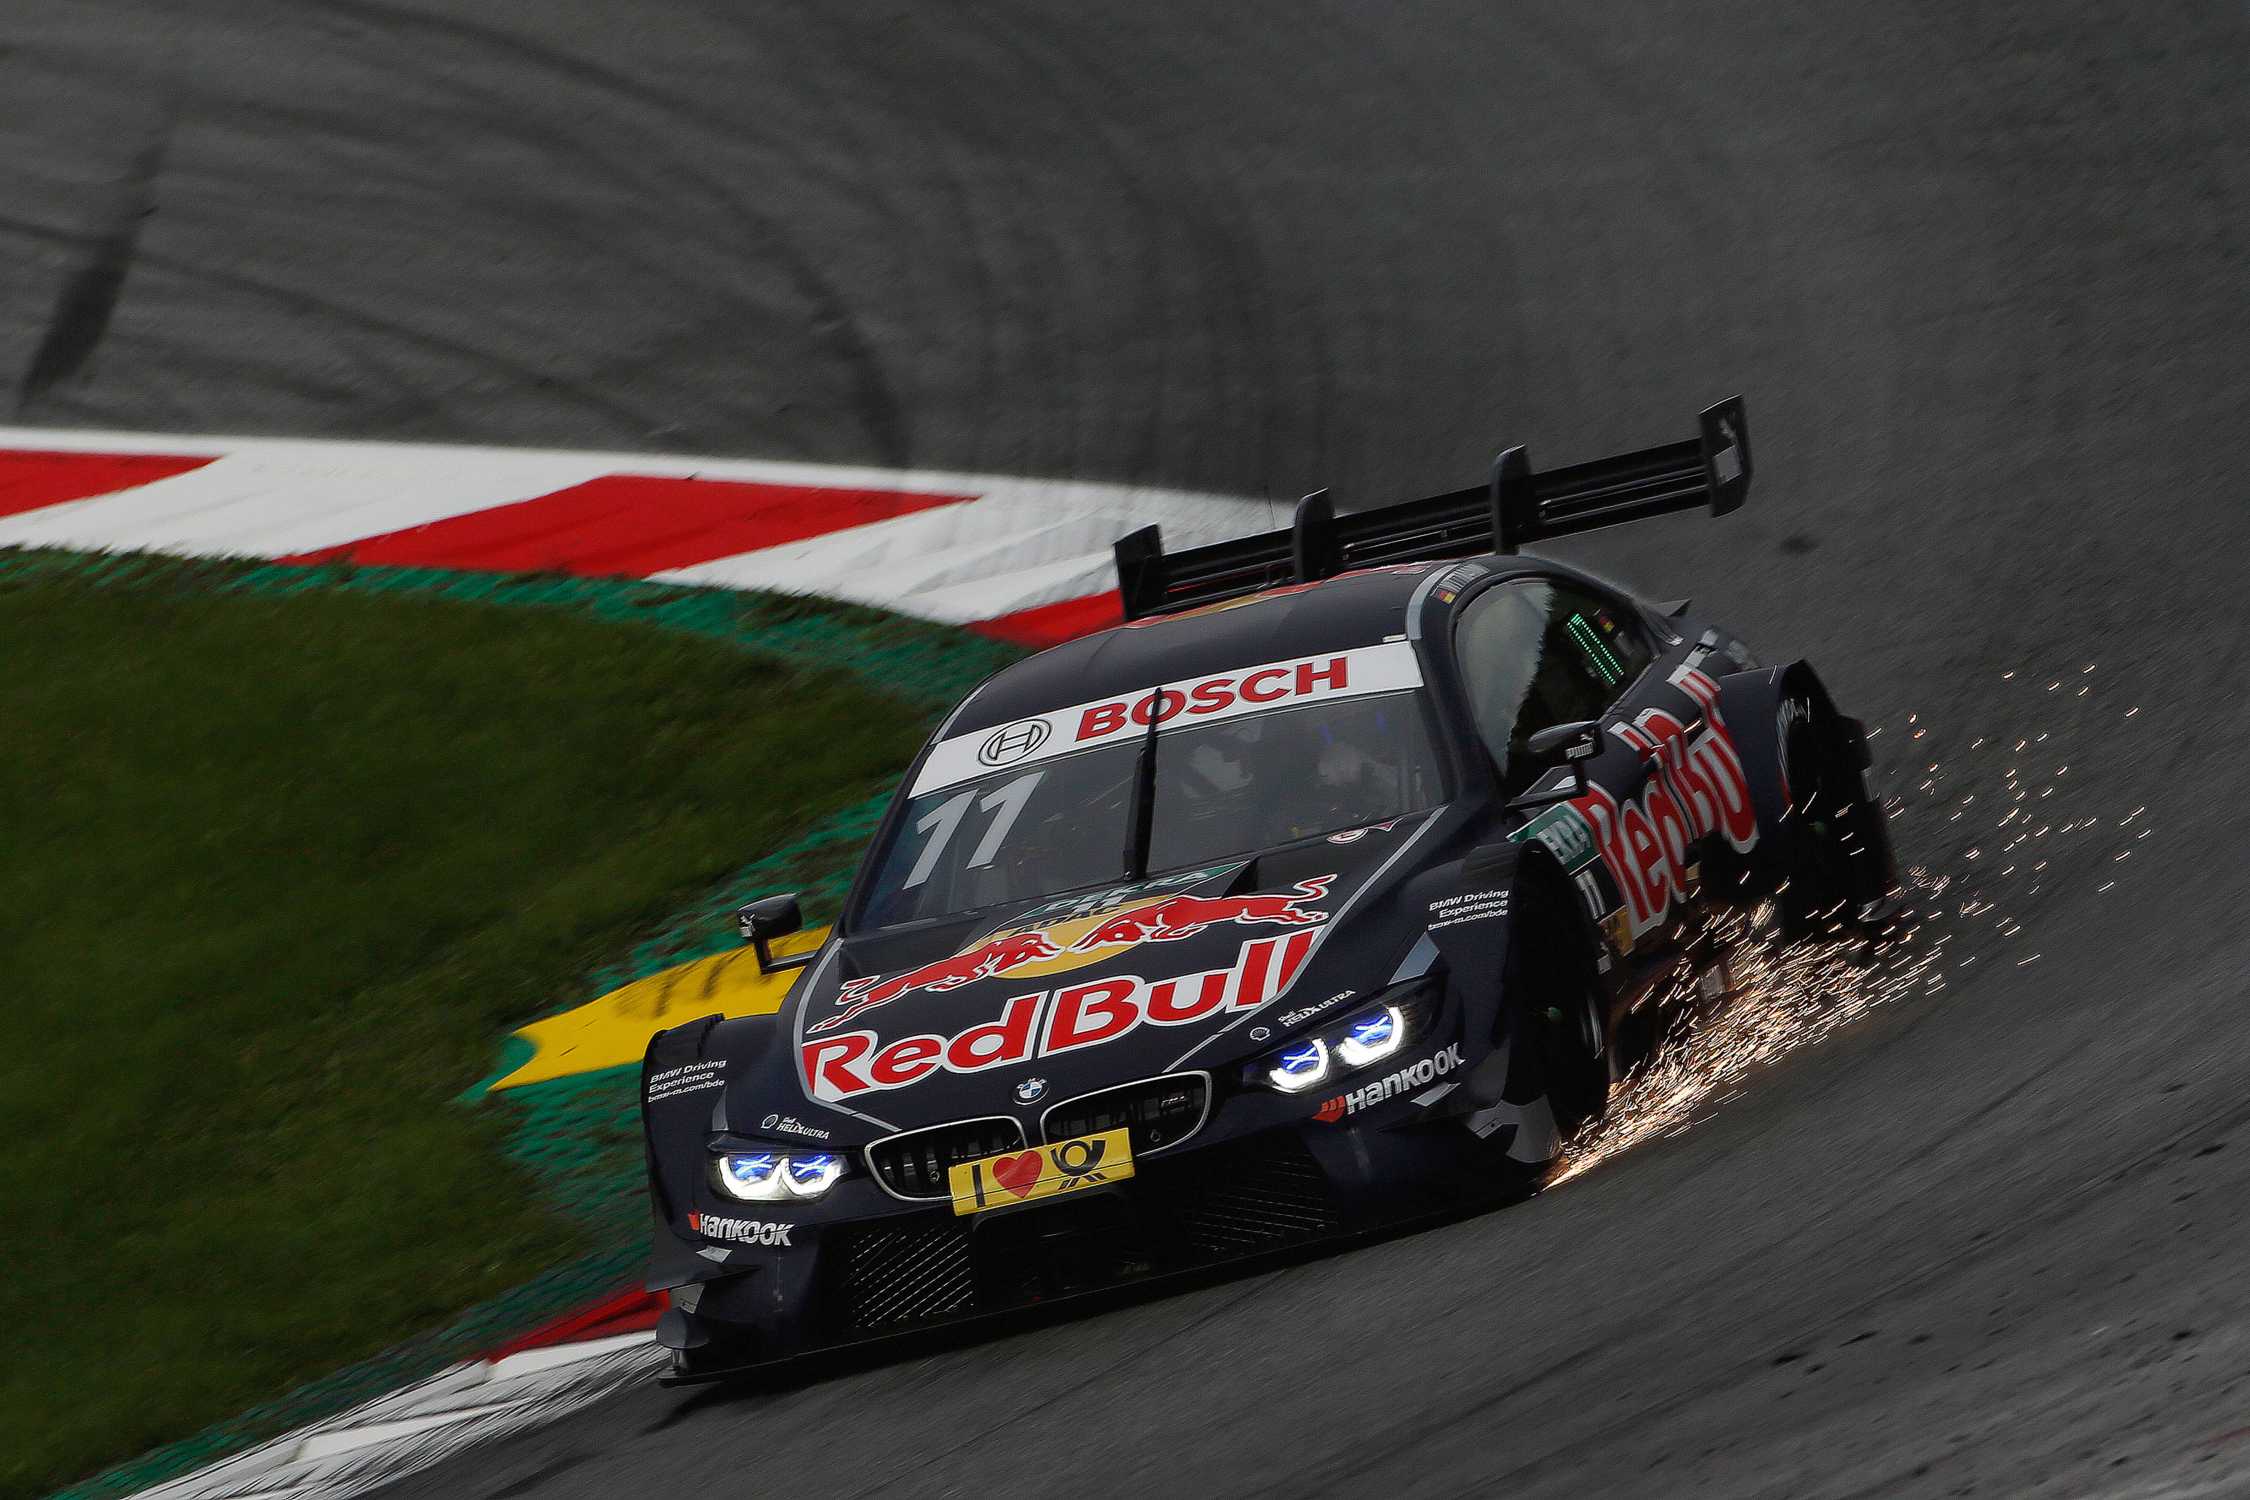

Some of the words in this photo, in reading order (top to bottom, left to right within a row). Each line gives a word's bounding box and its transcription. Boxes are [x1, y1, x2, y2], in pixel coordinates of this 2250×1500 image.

[1074, 656, 1348, 742] BOSCH
[903, 770, 1047, 890] 11
[1045, 871, 1209, 912] DEKRA
[1428, 895, 1463, 911] BMW
[1463, 890, 1509, 903] Driving
[1439, 900, 1508, 918] Experience
[1319, 990, 1356, 1009] ULTRA
[801, 991, 1048, 1102] Red
[1039, 926, 1327, 1058] Bull
[649, 1071, 715, 1094] Experience
[650, 1067, 683, 1083] BMW
[683, 1060, 728, 1074] Driving
[803, 1127, 830, 1140] ULTRA
